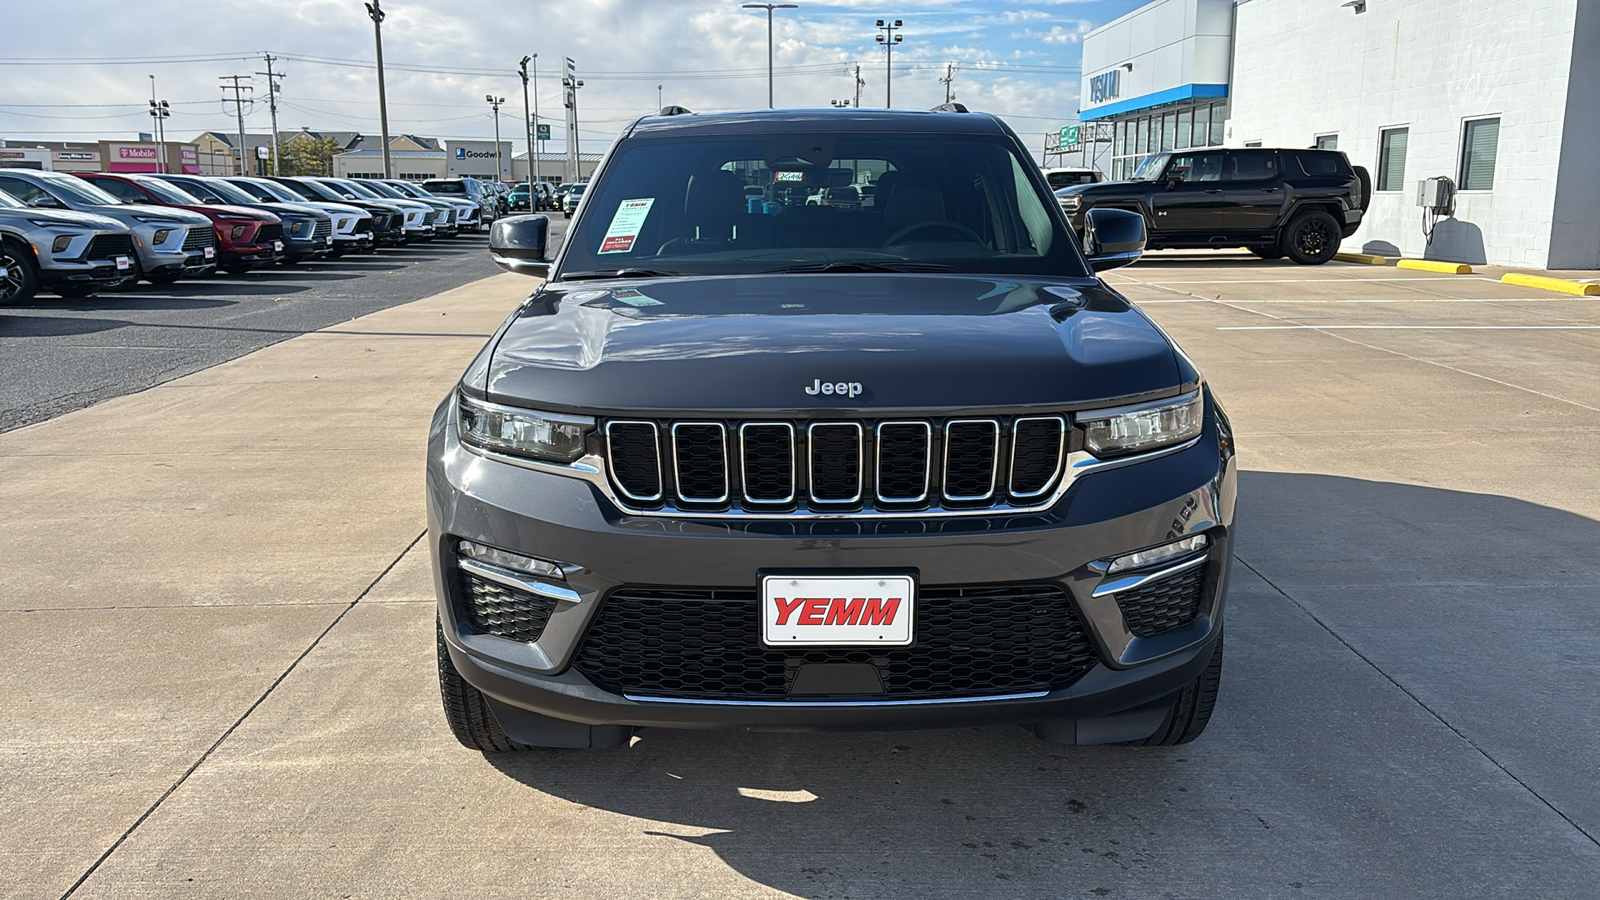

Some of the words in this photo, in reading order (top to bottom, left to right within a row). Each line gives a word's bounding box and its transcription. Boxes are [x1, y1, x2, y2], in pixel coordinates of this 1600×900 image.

[1090, 70, 1119, 102] YEMM
[805, 379, 863, 397] Jeep
[774, 598, 902, 626] YEMM
